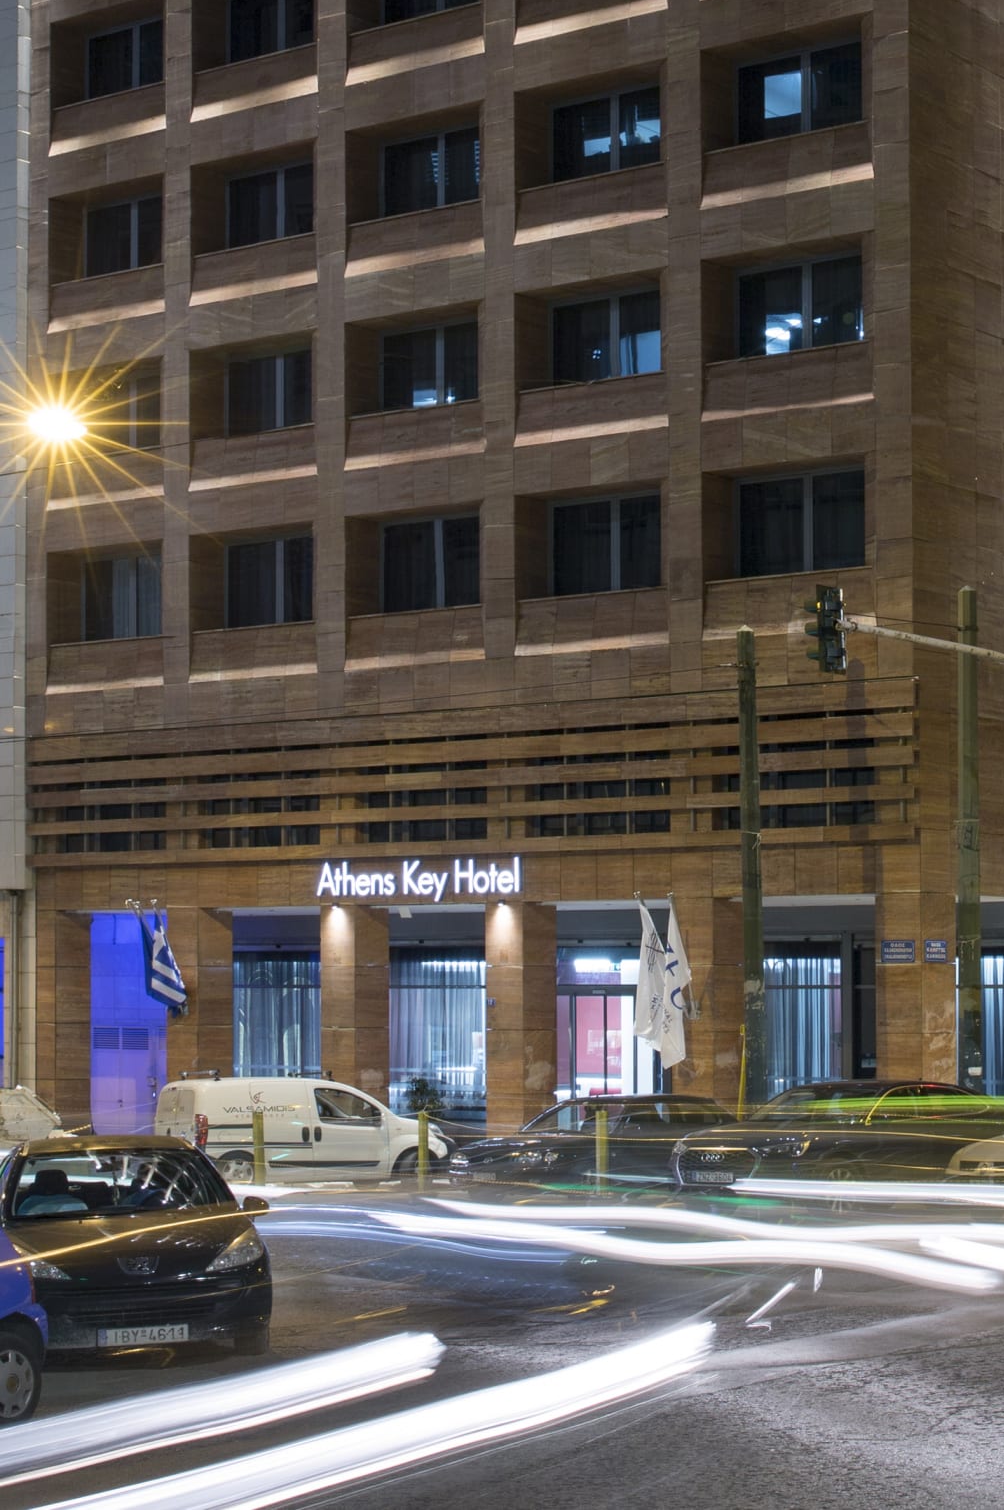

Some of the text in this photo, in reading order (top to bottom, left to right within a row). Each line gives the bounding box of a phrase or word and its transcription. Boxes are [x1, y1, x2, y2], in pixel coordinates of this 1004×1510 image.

[316, 856, 521, 902] Athens Key Hotel
[223, 1105, 296, 1114] VALSAMIDIS
